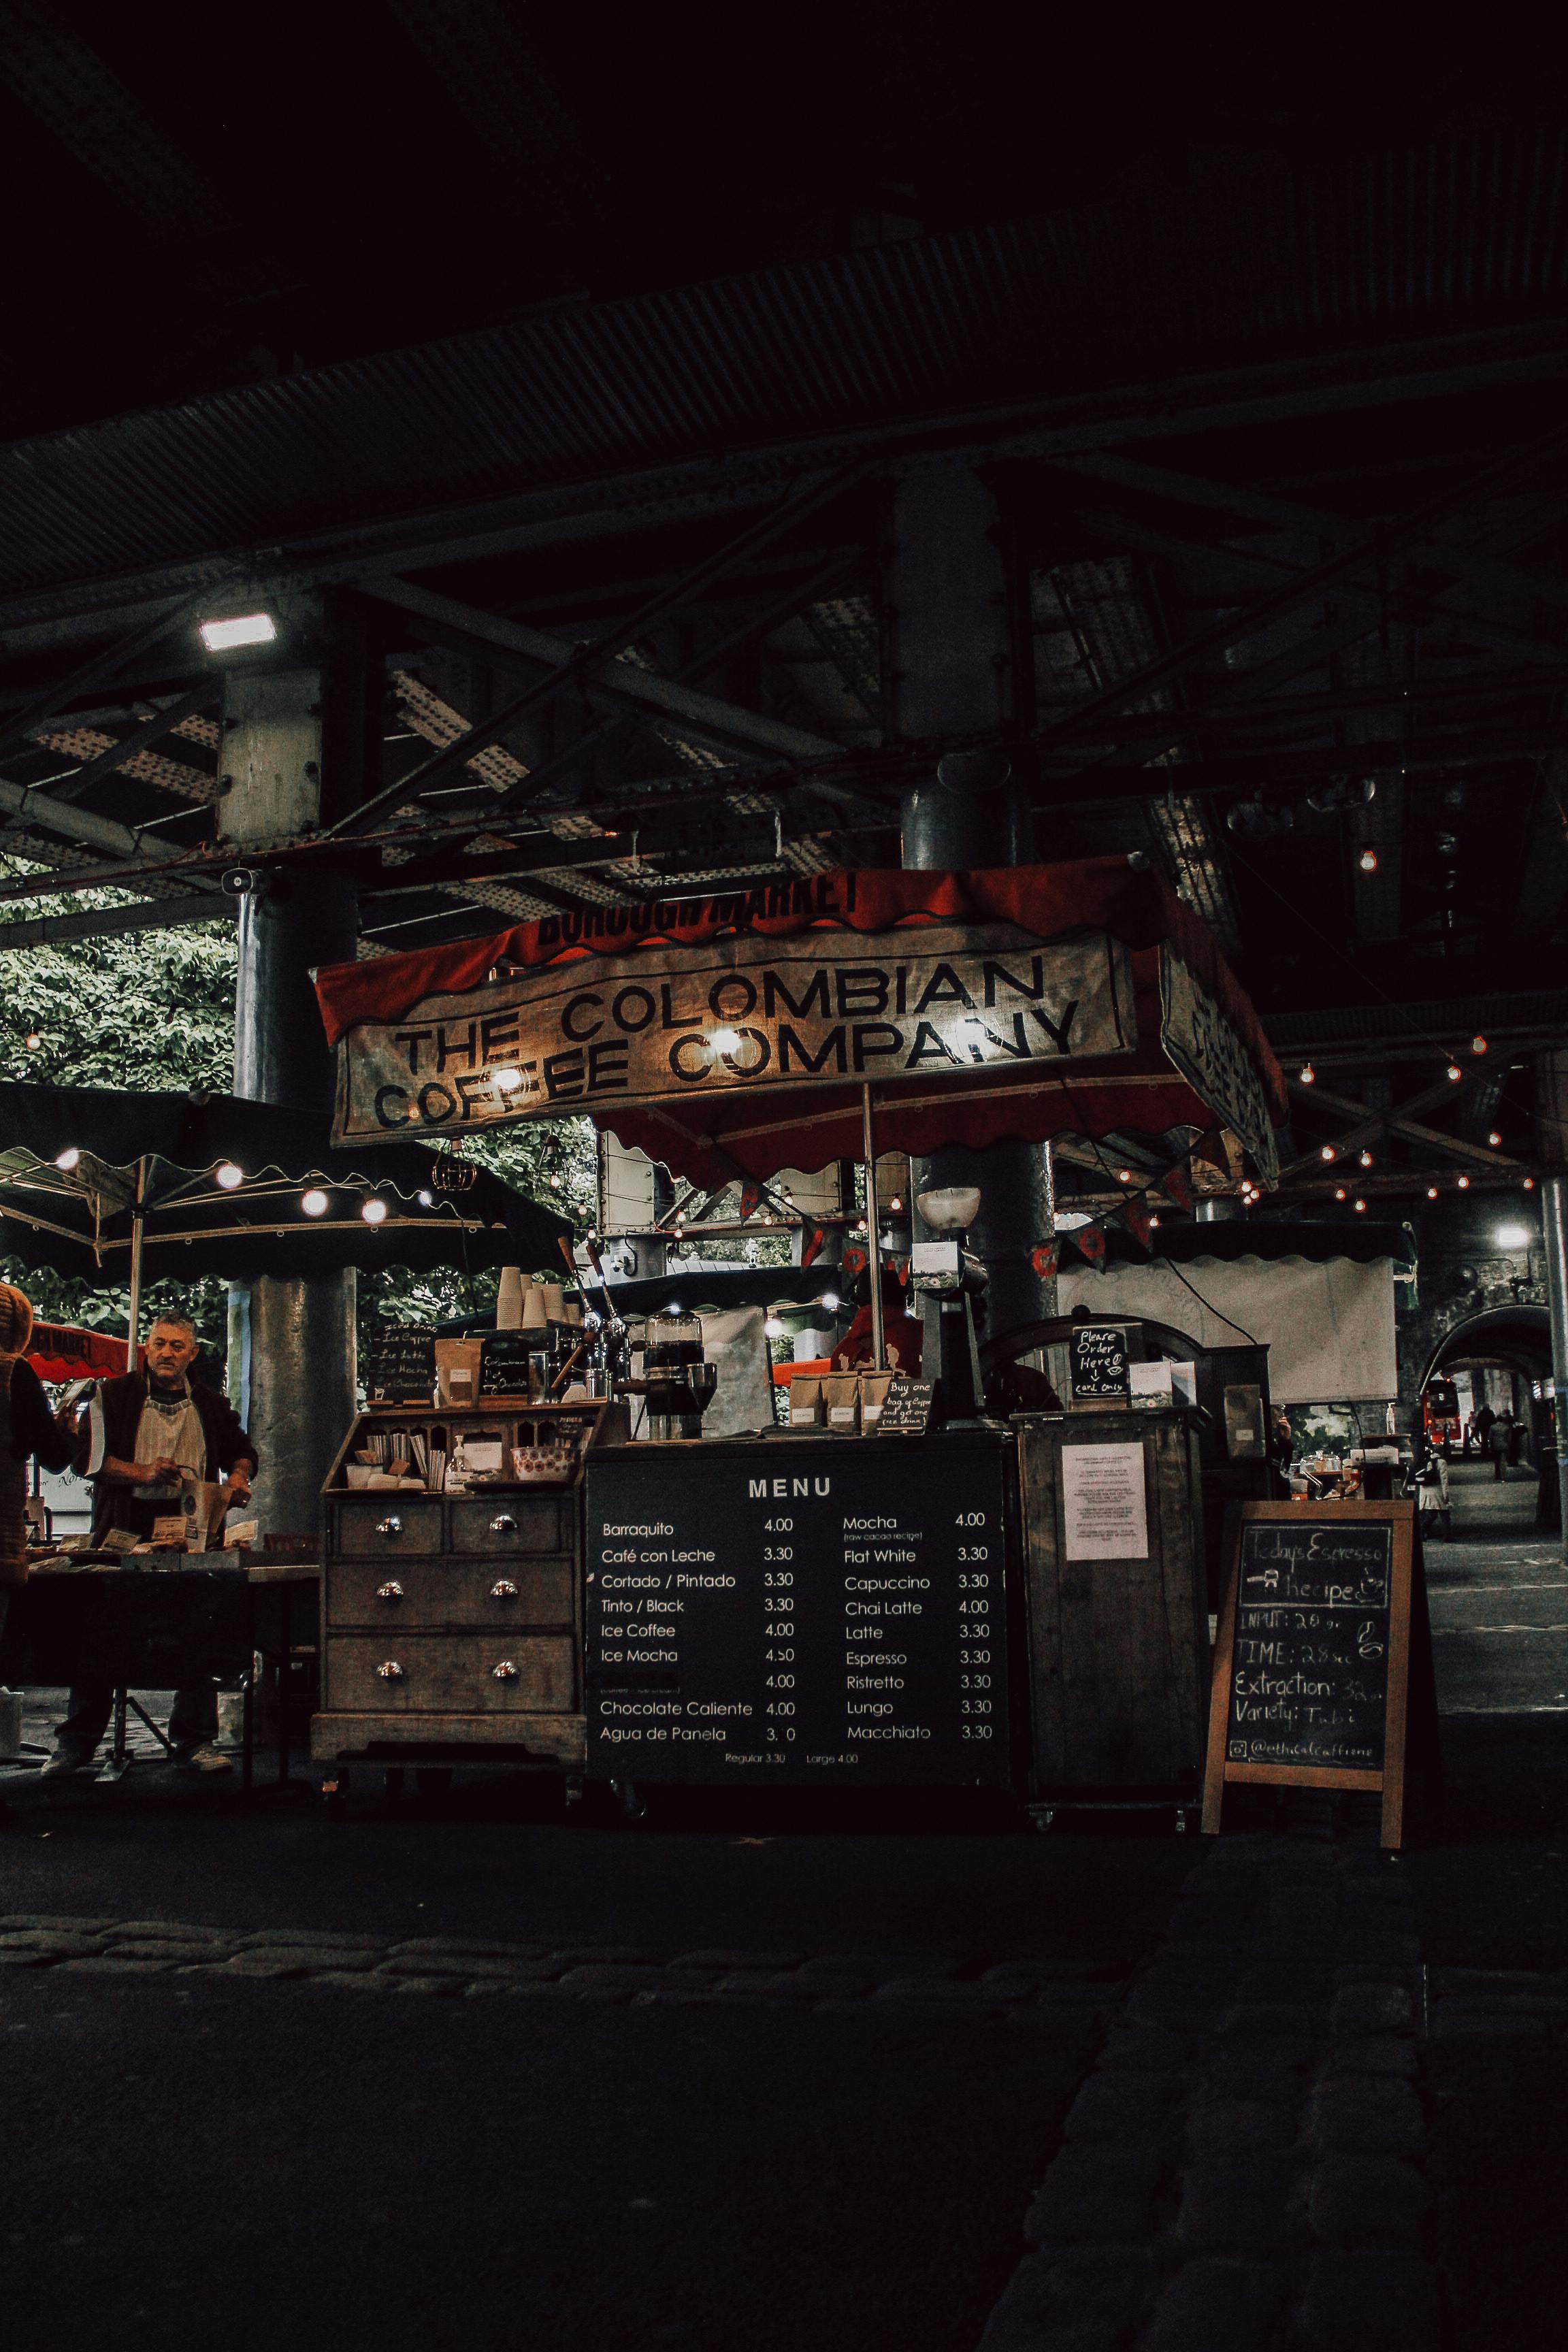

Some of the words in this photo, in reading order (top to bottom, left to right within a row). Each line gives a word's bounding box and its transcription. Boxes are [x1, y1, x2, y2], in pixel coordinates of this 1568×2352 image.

[395, 1011, 519, 1075] THE
[561, 956, 1043, 1042] COLOMBIAN
[374, 1039, 628, 1128] COFFEE
[669, 1000, 1079, 1082] COMPANY
[1081, 1330, 1116, 1343] Please
[1077, 1342, 1115, 1354] Order
[1081, 1357, 1111, 1371] Here
[890, 1382, 909, 1397] Buy
[887, 1396, 903, 1410] bag
[883, 1406, 897, 1416] and
[900, 1410, 913, 1420] get
[749, 1477, 830, 1498] MENU
[603, 1522, 674, 1538] Barraquito
[764, 1518, 793, 1531] 4.00
[843, 1516, 897, 1530] Mocha
[955, 1512, 985, 1526] 4.00
[602, 1549, 636, 1563] Café
[640, 1552, 667, 1563] con
[672, 1550, 715, 1563] Leche
[764, 1547, 793, 1561] 3.30
[844, 1550, 870, 1563] Flat
[874, 1548, 916, 1563] White
[958, 1547, 988, 1561] 3.30
[1307, 1533, 1383, 1565] Espresso
[602, 1574, 661, 1588] Cortado
[665, 1574, 672, 1589] /
[677, 1573, 736, 1588] Pintado
[764, 1572, 794, 1586] 3.30
[845, 1575, 930, 1592] Capuccino
[958, 1573, 989, 1588] 3.30
[602, 1599, 633, 1612] Tinto
[636, 1599, 642, 1614] /
[647, 1599, 684, 1612] Black
[764, 1598, 794, 1612] 3.30
[845, 1601, 881, 1616] Chai
[884, 1601, 923, 1615] Latte
[959, 1600, 989, 1614] 4.00
[602, 1624, 623, 1637] Ice
[626, 1623, 676, 1637] Coffee
[765, 1622, 794, 1636] 4.00
[846, 1626, 883, 1639] Latte
[960, 1624, 990, 1638] 3.30
[602, 1650, 623, 1661] Ice
[627, 1650, 678, 1662] Mocha
[846, 1652, 907, 1667] Espresso
[960, 1650, 990, 1664] 3.30
[766, 1674, 796, 1688] 4.00
[847, 1676, 904, 1689] Ristretto
[960, 1675, 991, 1688] 3.30
[600, 1701, 682, 1715] Chocolate
[687, 1701, 753, 1716] Caliente
[766, 1702, 796, 1715] 4.00
[847, 1701, 894, 1717] Lungo
[961, 1700, 992, 1714] 3.30
[600, 1727, 641, 1742] Agua
[647, 1727, 667, 1741] de
[672, 1727, 726, 1741] Panela
[847, 1726, 931, 1740] Macchiato
[962, 1725, 992, 1739] 3.30
[725, 1753, 764, 1764] Regular
[806, 1754, 835, 1765] Large
[838, 1754, 858, 1764] 4.00
